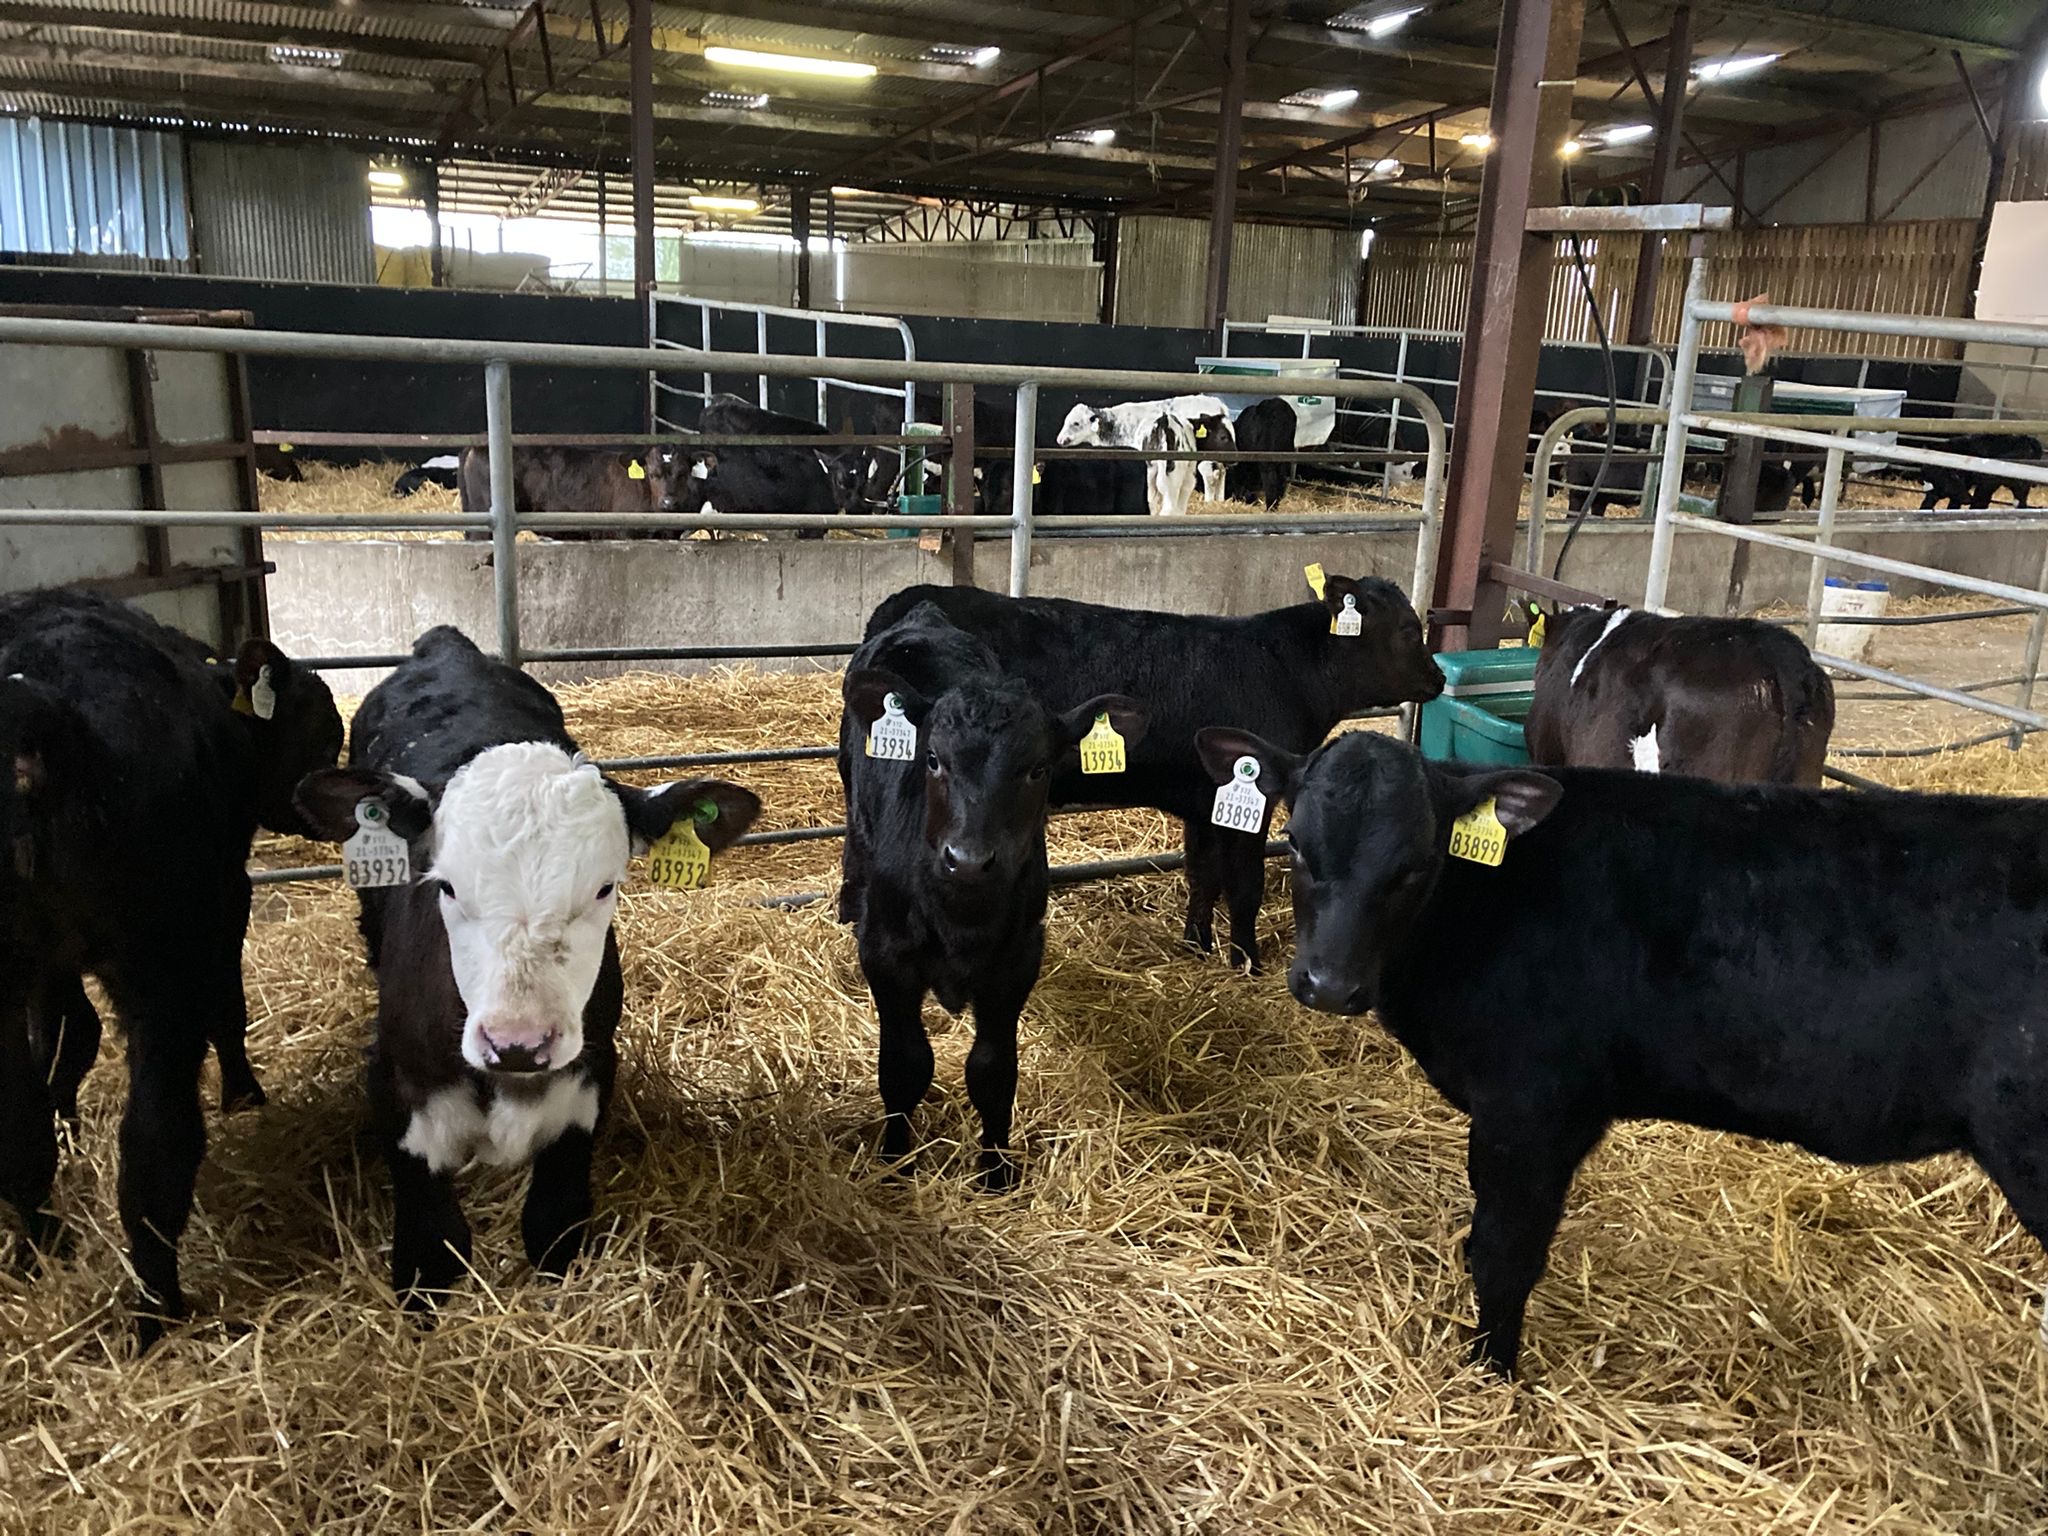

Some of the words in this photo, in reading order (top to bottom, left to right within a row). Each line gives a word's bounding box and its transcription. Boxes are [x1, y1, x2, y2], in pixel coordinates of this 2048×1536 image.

[872, 735, 912, 759] 13934
[1083, 750, 1122, 772] 13934
[1215, 801, 1260, 831] 83899
[1452, 831, 1500, 863] 83899
[349, 858, 407, 885] 83932
[651, 858, 706, 888] 83932
